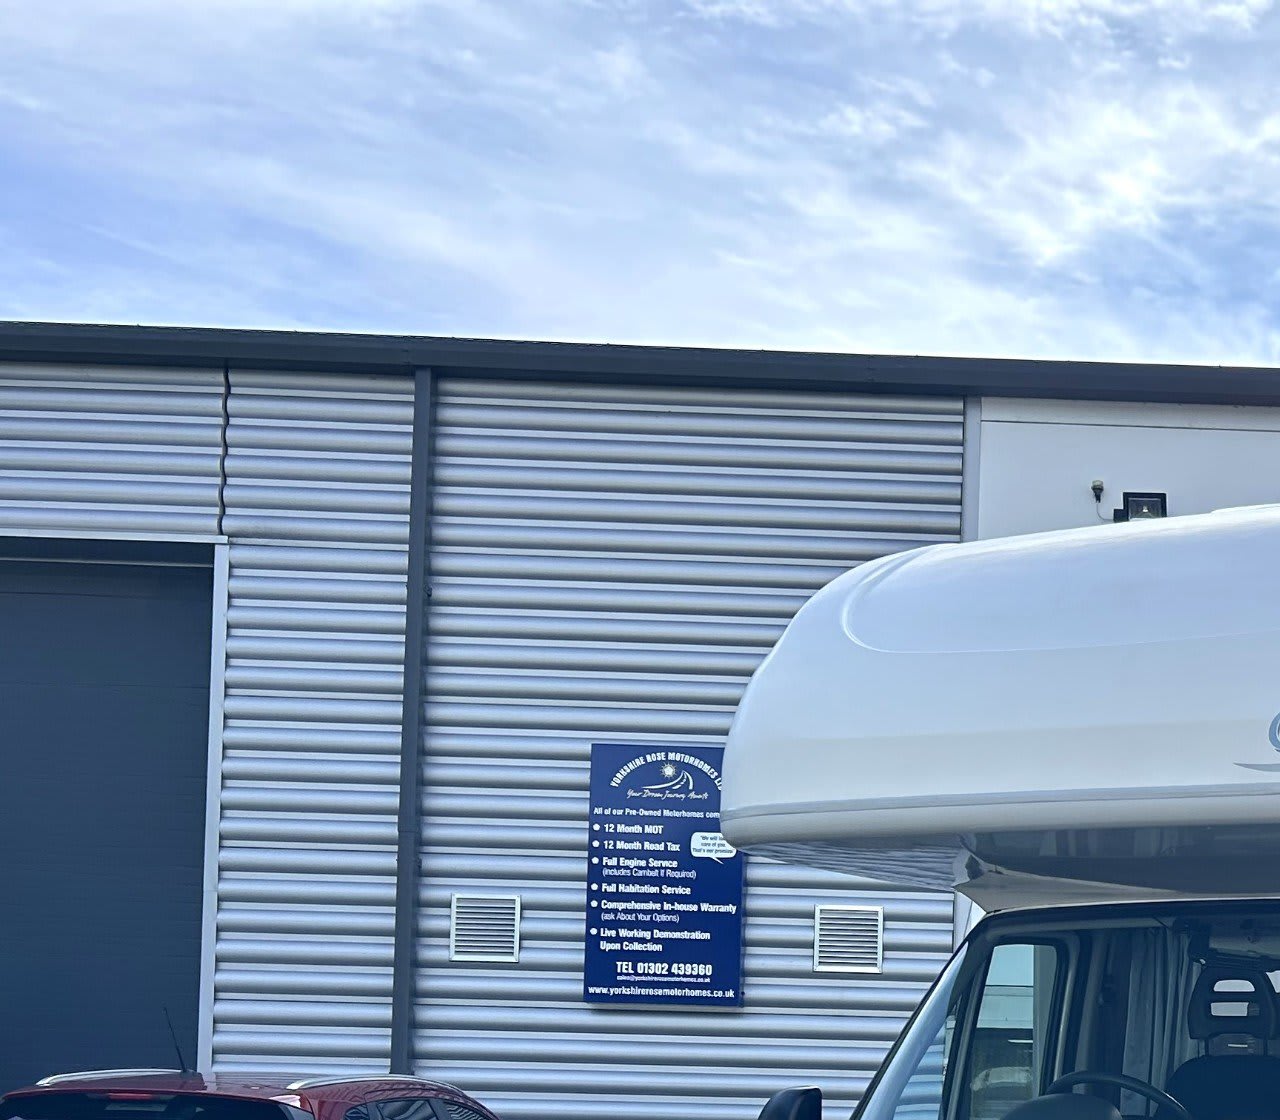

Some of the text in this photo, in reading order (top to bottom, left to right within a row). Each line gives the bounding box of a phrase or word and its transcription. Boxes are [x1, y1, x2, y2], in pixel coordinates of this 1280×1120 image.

[610, 756, 646, 788] YORKSHIRE
[646, 751, 666, 763] ROSE
[668, 751, 719, 780] MOTORHOMES
[593, 807, 602, 815] All
[604, 807, 611, 815] of
[625, 808, 661, 817] Pre-Owned
[663, 810, 704, 818] Motorhomes
[706, 811, 720, 819] com
[603, 824, 664, 835] 12 Month MOT
[603, 841, 681, 852] 12 Month Road Tax
[602, 857, 678, 868] Full Engine Service
[632, 868, 659, 878] Cambelt
[666, 869, 697, 880] Required)
[601, 883, 691, 894] Full Habitation Service
[601, 900, 737, 915] Comprehensive In-house Warranty
[601, 912, 679, 922] (ask About Your Options)
[600, 927, 711, 940] Live Working Demonstration
[600, 940, 663, 952] Upon Collection
[615, 961, 713, 976] TEL 01302 439360
[588, 986, 735, 998] www.yorkshirerosemotorhomes.co.uk
